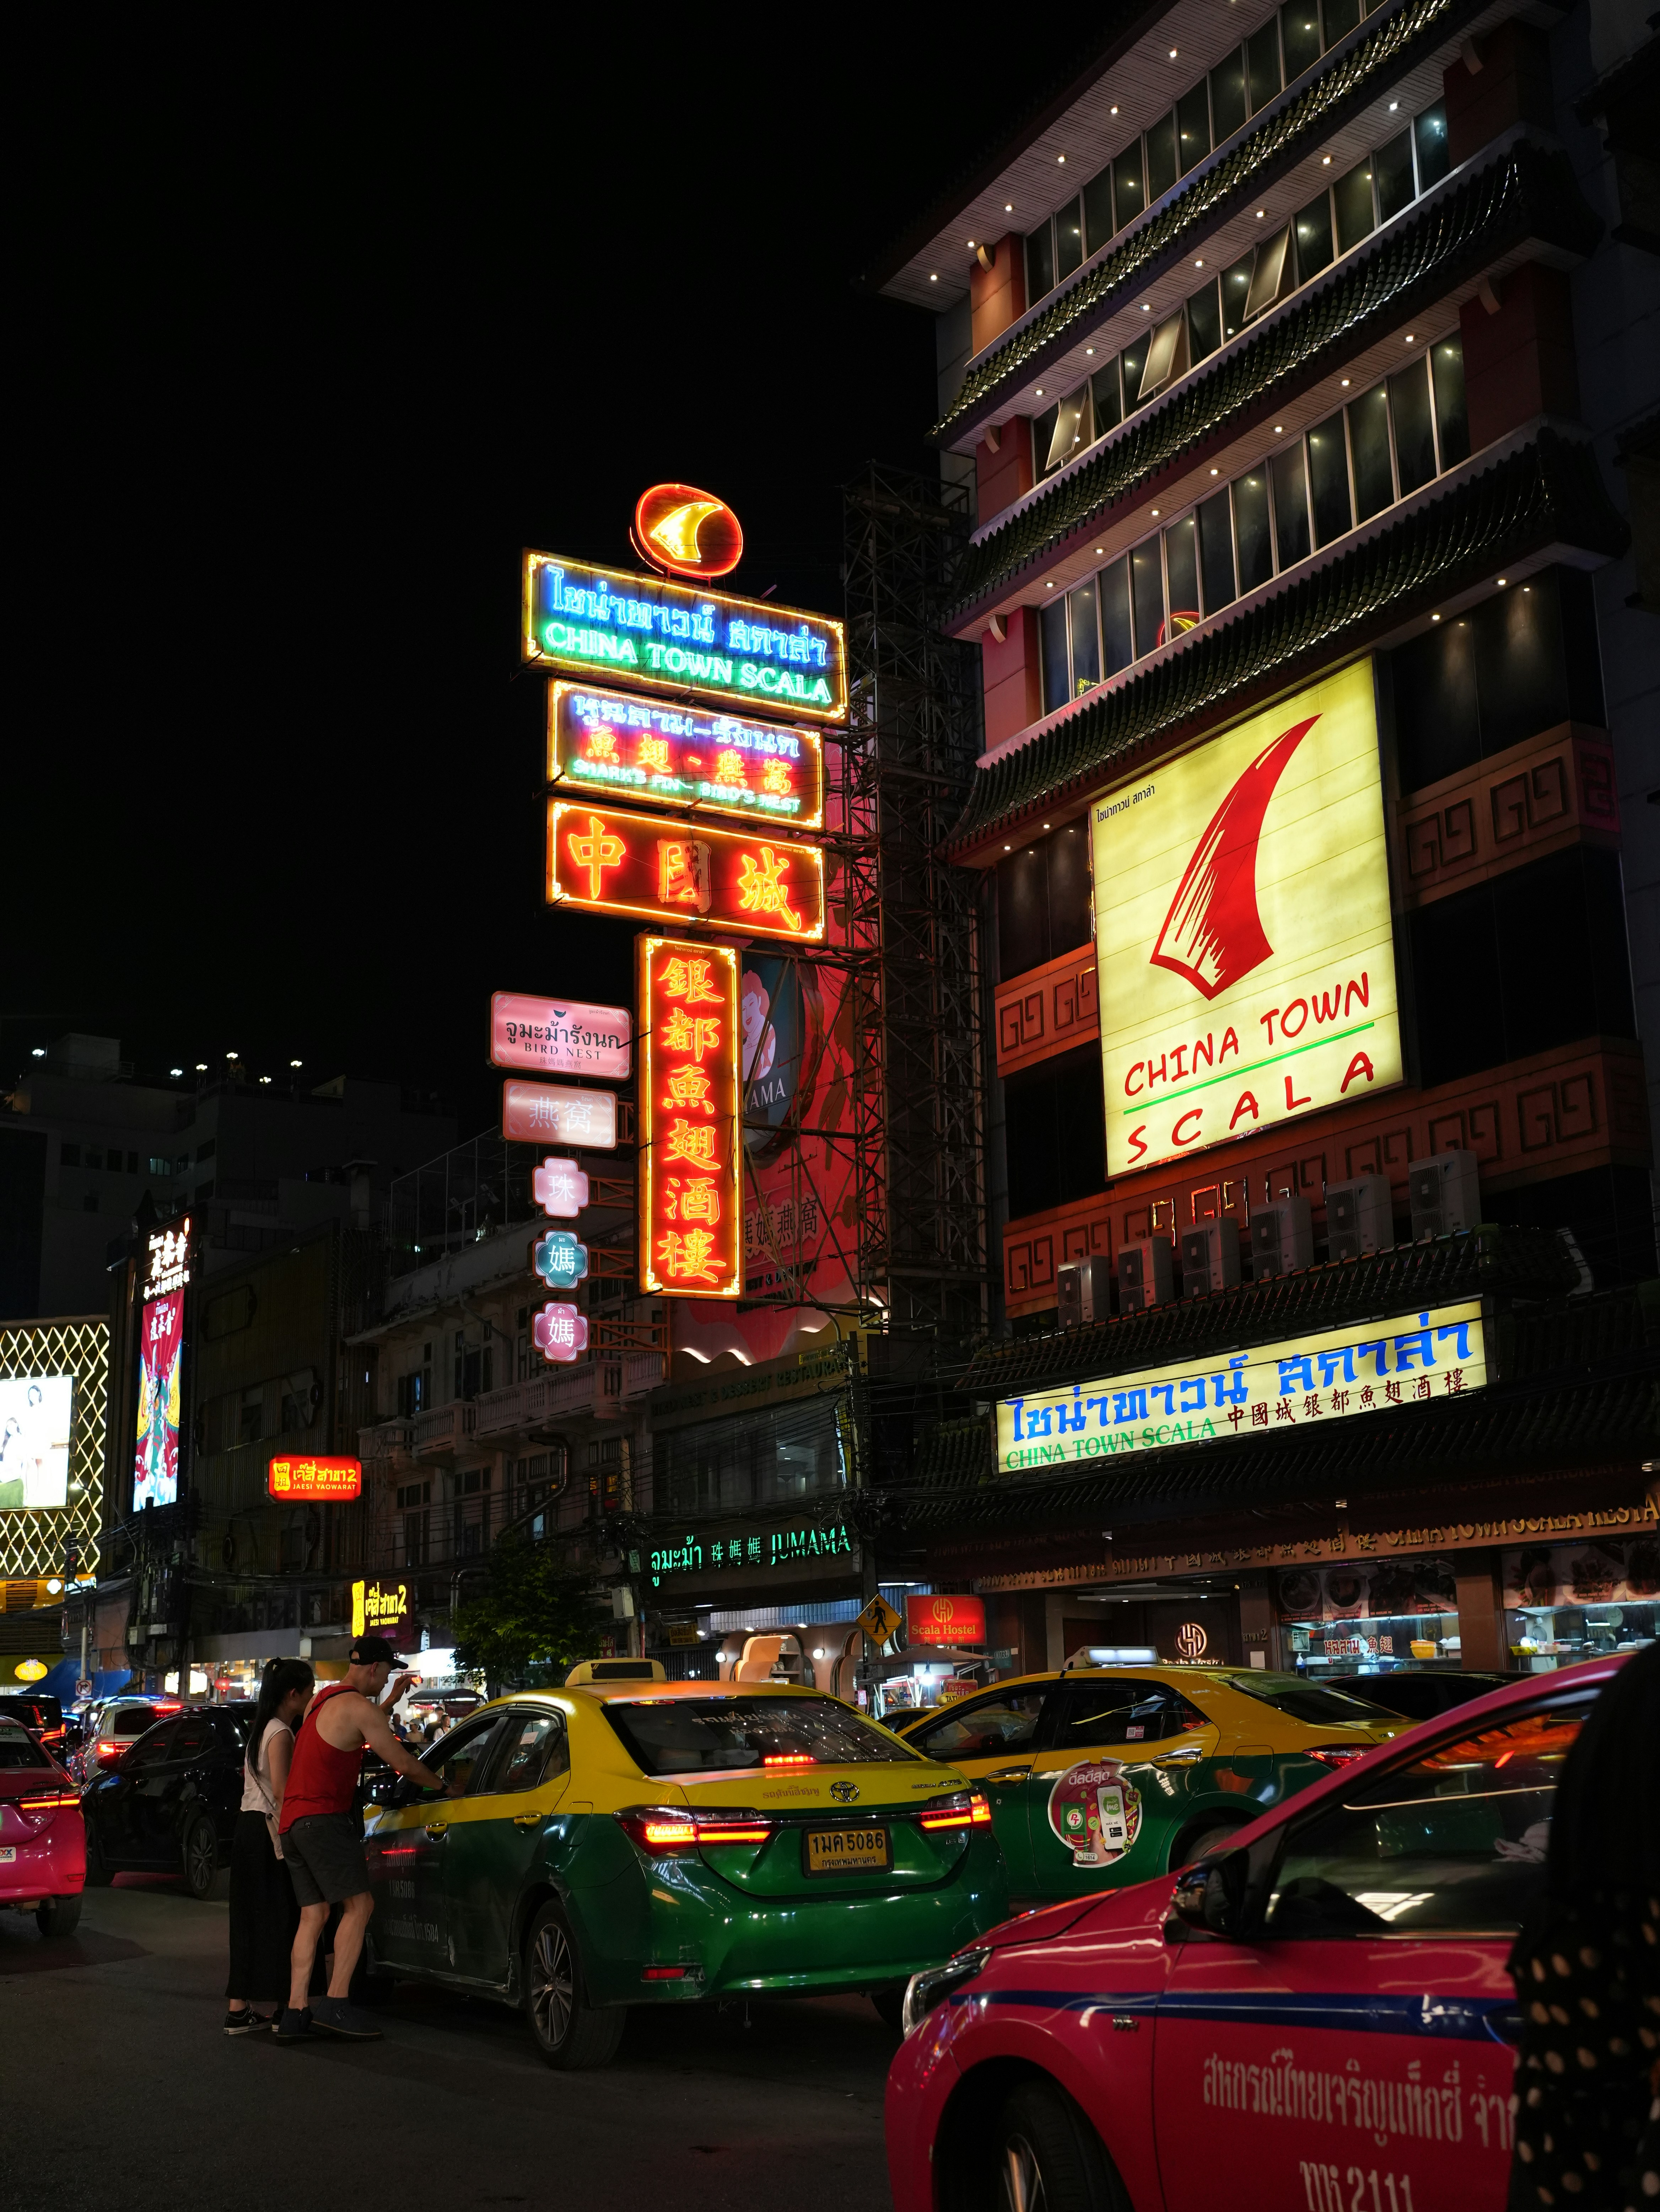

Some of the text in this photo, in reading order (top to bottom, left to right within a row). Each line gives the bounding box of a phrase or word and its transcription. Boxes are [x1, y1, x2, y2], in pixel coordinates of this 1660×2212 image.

[546, 564, 827, 667] ไชน่าทาวน์ สกาล่า
[545, 622, 832, 703] CHINA TOWN SCALA
[573, 759, 647, 784] SHARK'S
[699, 782, 756, 804] BIRD'S
[759, 794, 801, 813] NEST
[1096, 784, 1155, 823] ไชน่าทาวน์ สกาล่า
[567, 816, 802, 931] 中國城
[506, 1021, 619, 1049] จูมะม้ารังนก
[524, 1042, 602, 1060] BIRD NEST
[1124, 972, 1369, 1096] CHINA TOWN
[745, 1077, 786, 1114] AMA
[1127, 1052, 1374, 1164] SCALA
[657, 957, 727, 1283] 銀都魚翅酒樓
[548, 1174, 575, 1202] 珠
[548, 1245, 575, 1275] 媽
[548, 1316, 575, 1347] 媽
[776, 1358, 850, 1388] RESTAURAN
[1005, 1312, 1474, 1442] ไชน่าทาวน์ สกาล่า
[1228, 1368, 1468, 1432] 中國城銀都魚翅酒樓
[1006, 1418, 1216, 1469] CHINA TOWN SCALA
[276, 1465, 289, 1487] 四姐
[651, 1535, 702, 1586] จูมะม้า
[771, 1525, 851, 1565] JUMAMA
[370, 1617, 399, 1626] JAESI YAOWARAT
[911, 1625, 976, 1634] Scala Hostel
[1324, 1639, 1360, 1665] หูฉลาม
[1367, 1636, 1393, 1654] 魚翅
[1069, 1770, 1110, 1784] ดีลดีสุด
[846, 1832, 883, 1851] 5086
[822, 1856, 876, 1868] กรุงเทพมหานคร
[1347, 2166, 1413, 2212] 2111
